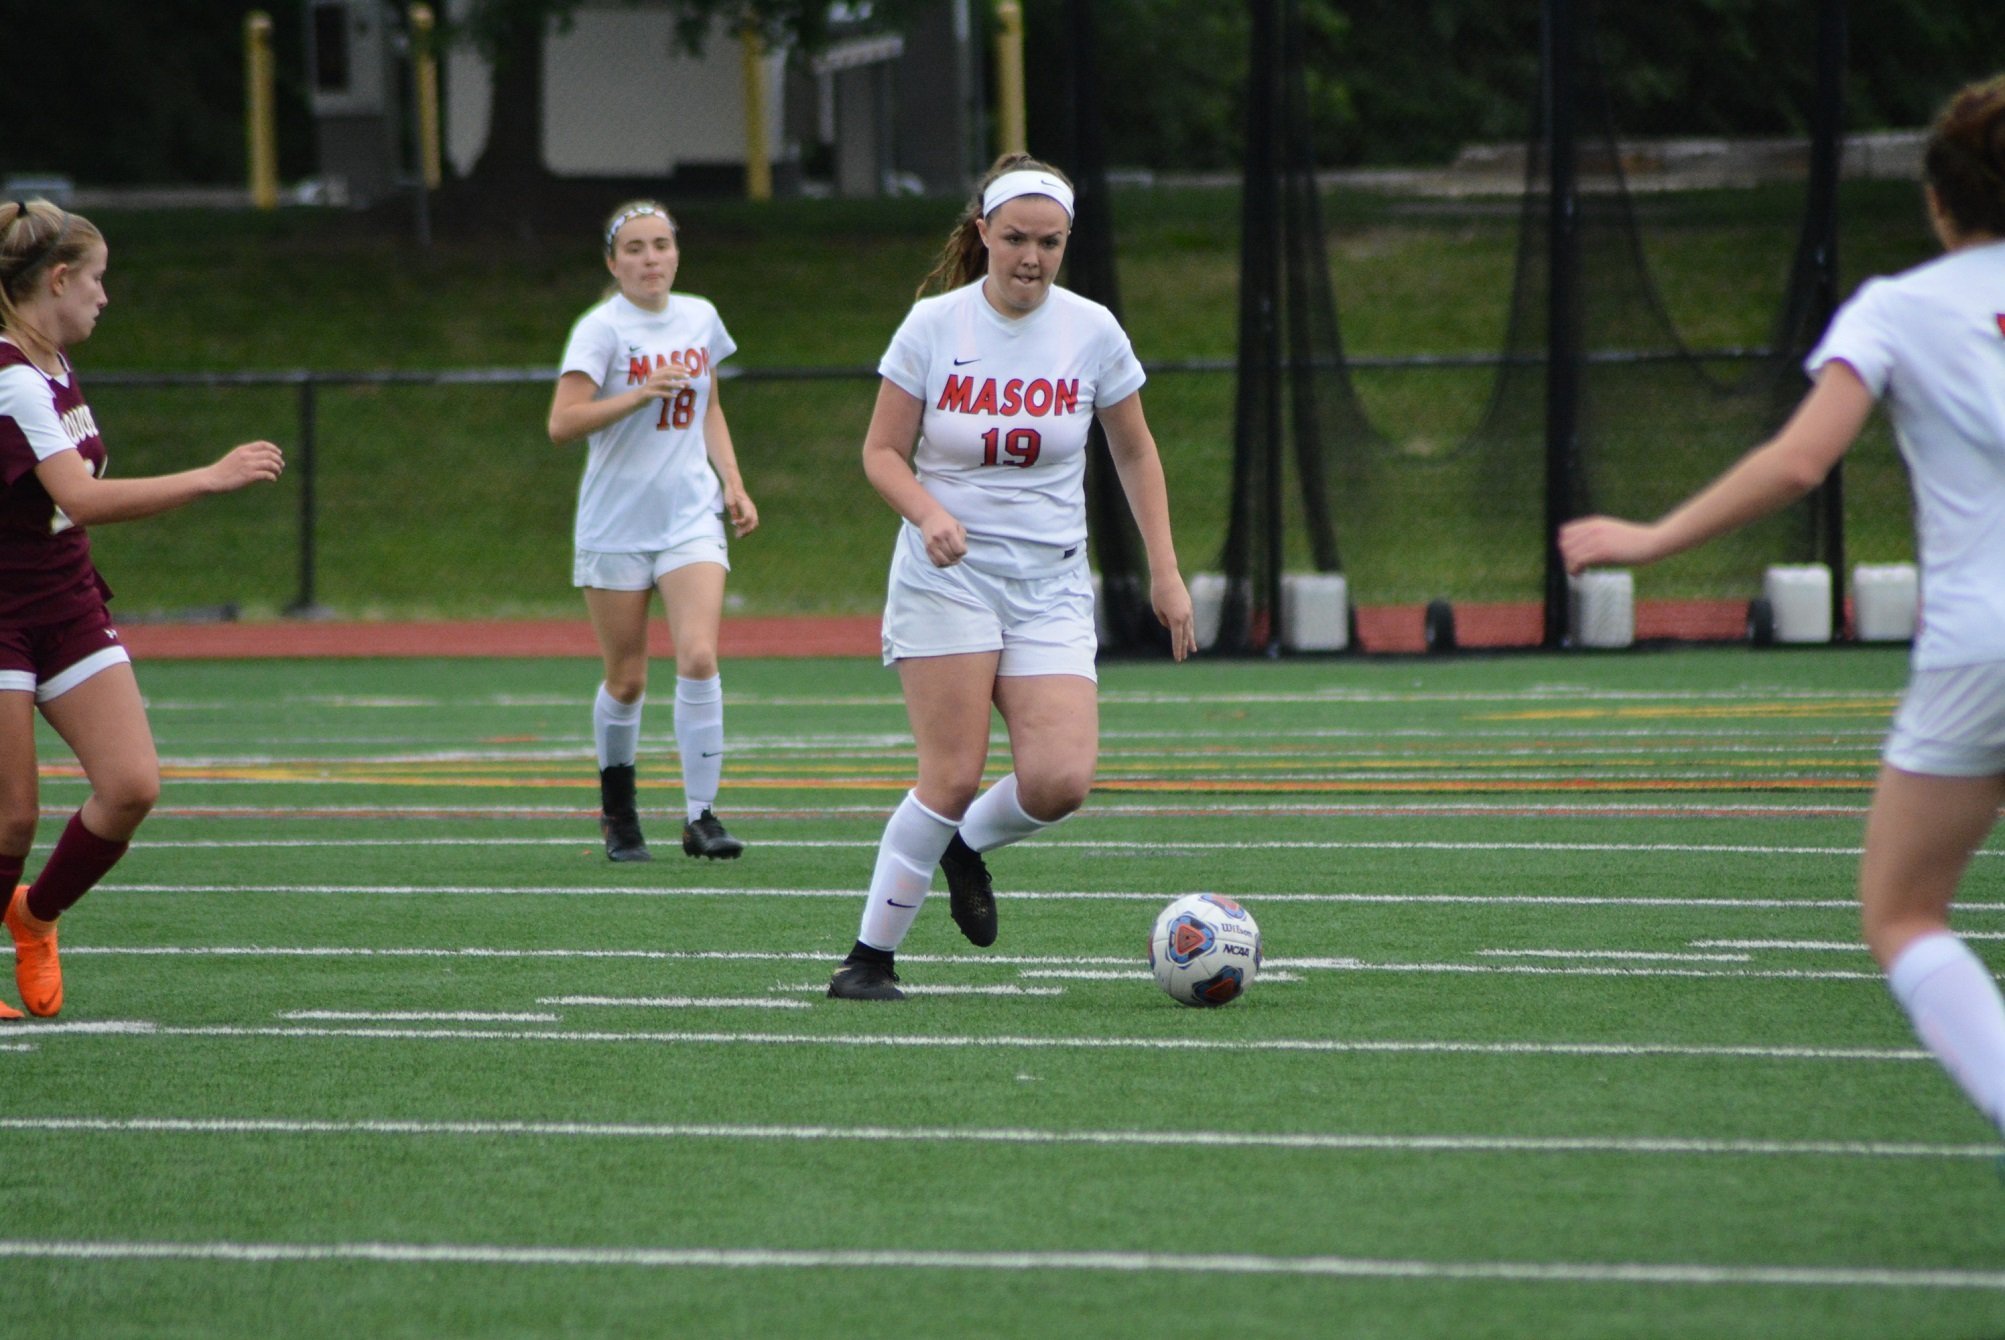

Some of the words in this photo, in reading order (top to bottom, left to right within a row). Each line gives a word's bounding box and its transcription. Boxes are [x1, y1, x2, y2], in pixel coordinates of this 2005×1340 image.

[656, 388, 697, 431] 18
[937, 374, 1079, 417] MASON
[980, 427, 1041, 468] 19
[1222, 943, 1250, 957] NCAA
